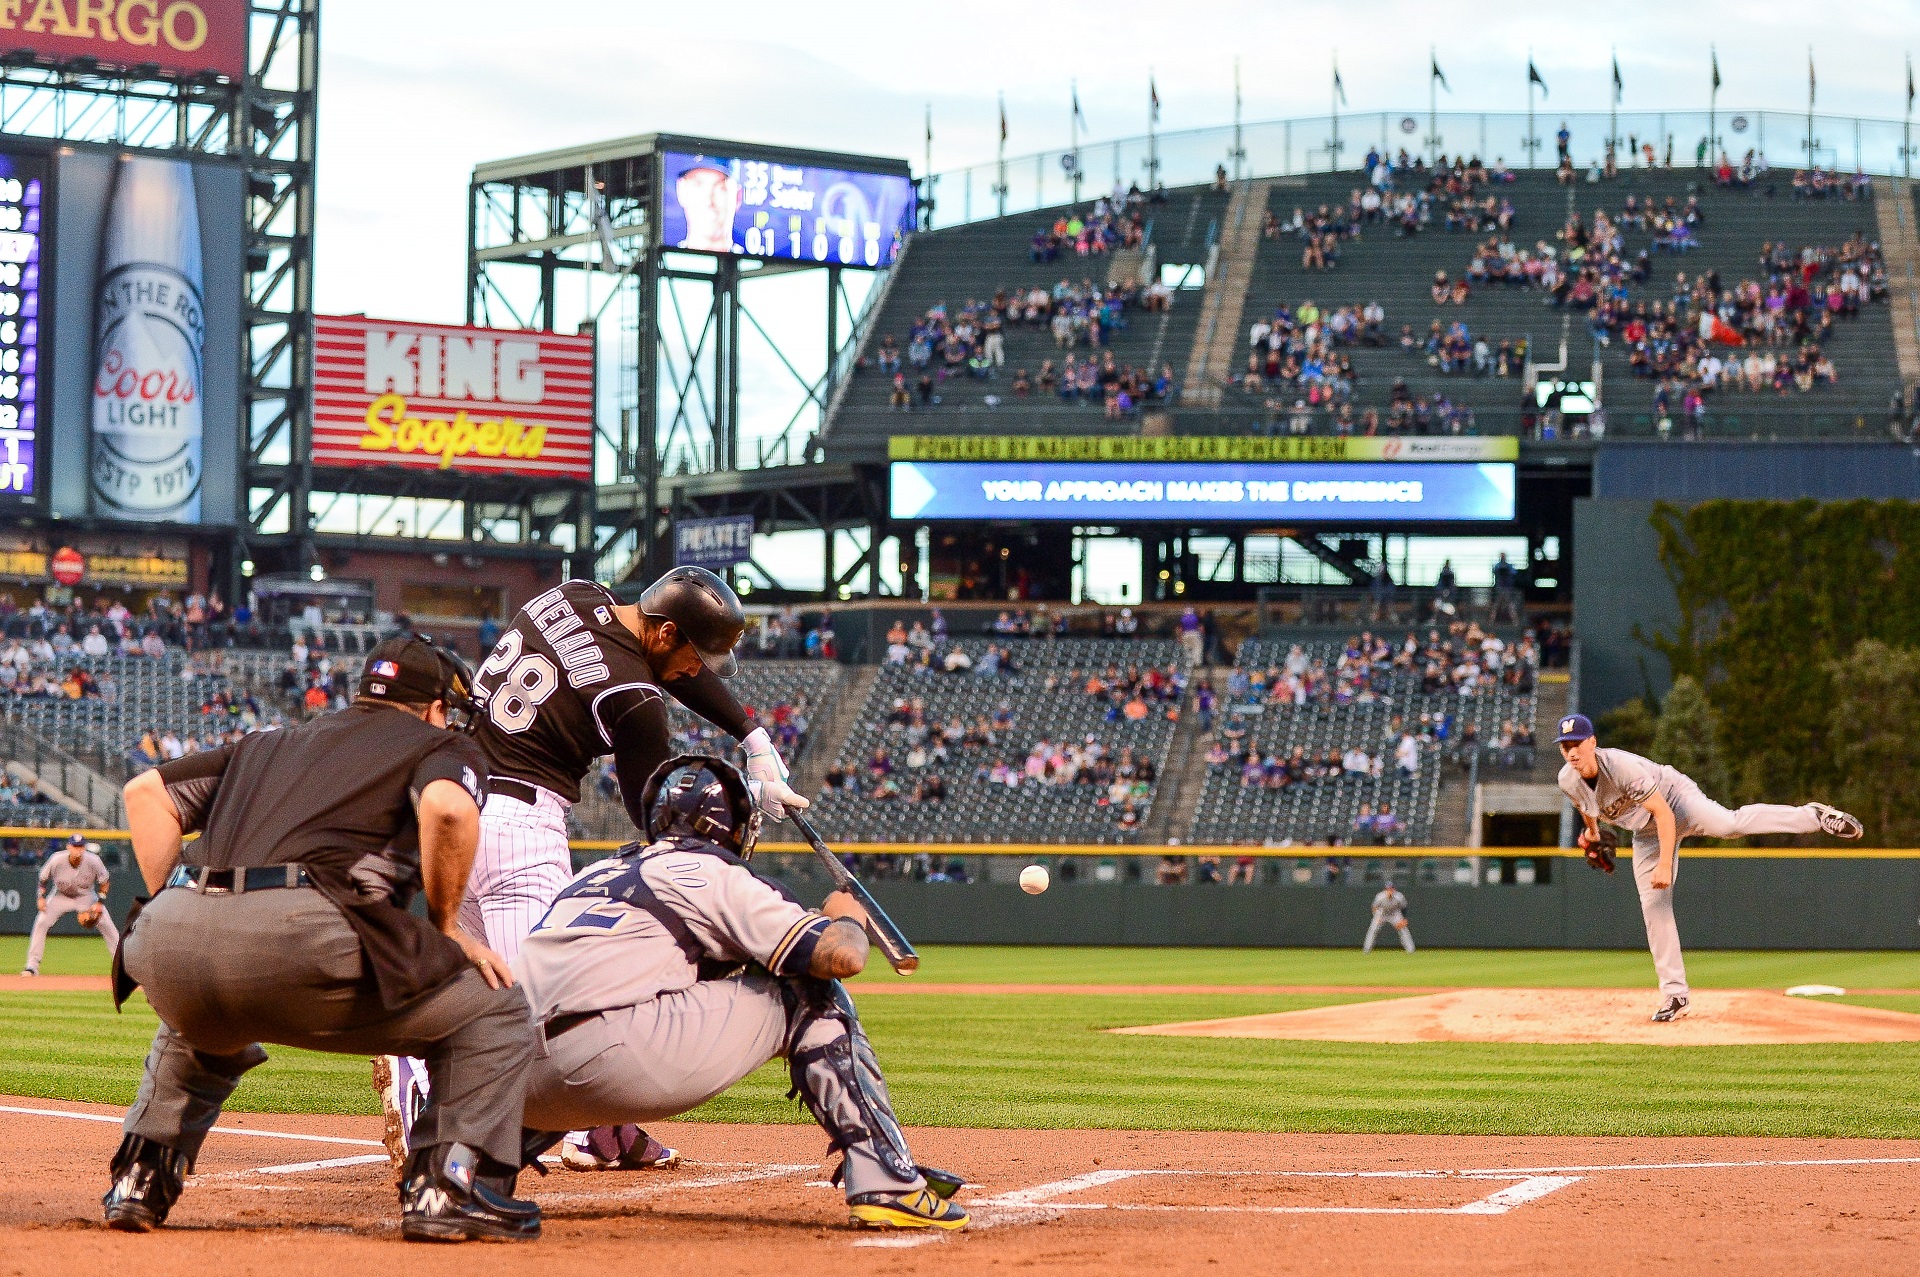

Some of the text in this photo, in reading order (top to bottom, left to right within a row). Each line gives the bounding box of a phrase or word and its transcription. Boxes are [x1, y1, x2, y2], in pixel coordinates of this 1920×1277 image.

[121, 282, 170, 305] THE
[95, 349, 195, 404] Coors
[366, 330, 545, 403] KING
[108, 401, 180, 428] LIGHT
[360, 394, 548, 469] Soopers
[983, 480, 1423, 502] YOUR APPROACH MAKES THE DIFFERENCE
[521, 587, 610, 689] RENADO
[474, 629, 558, 734] 28
